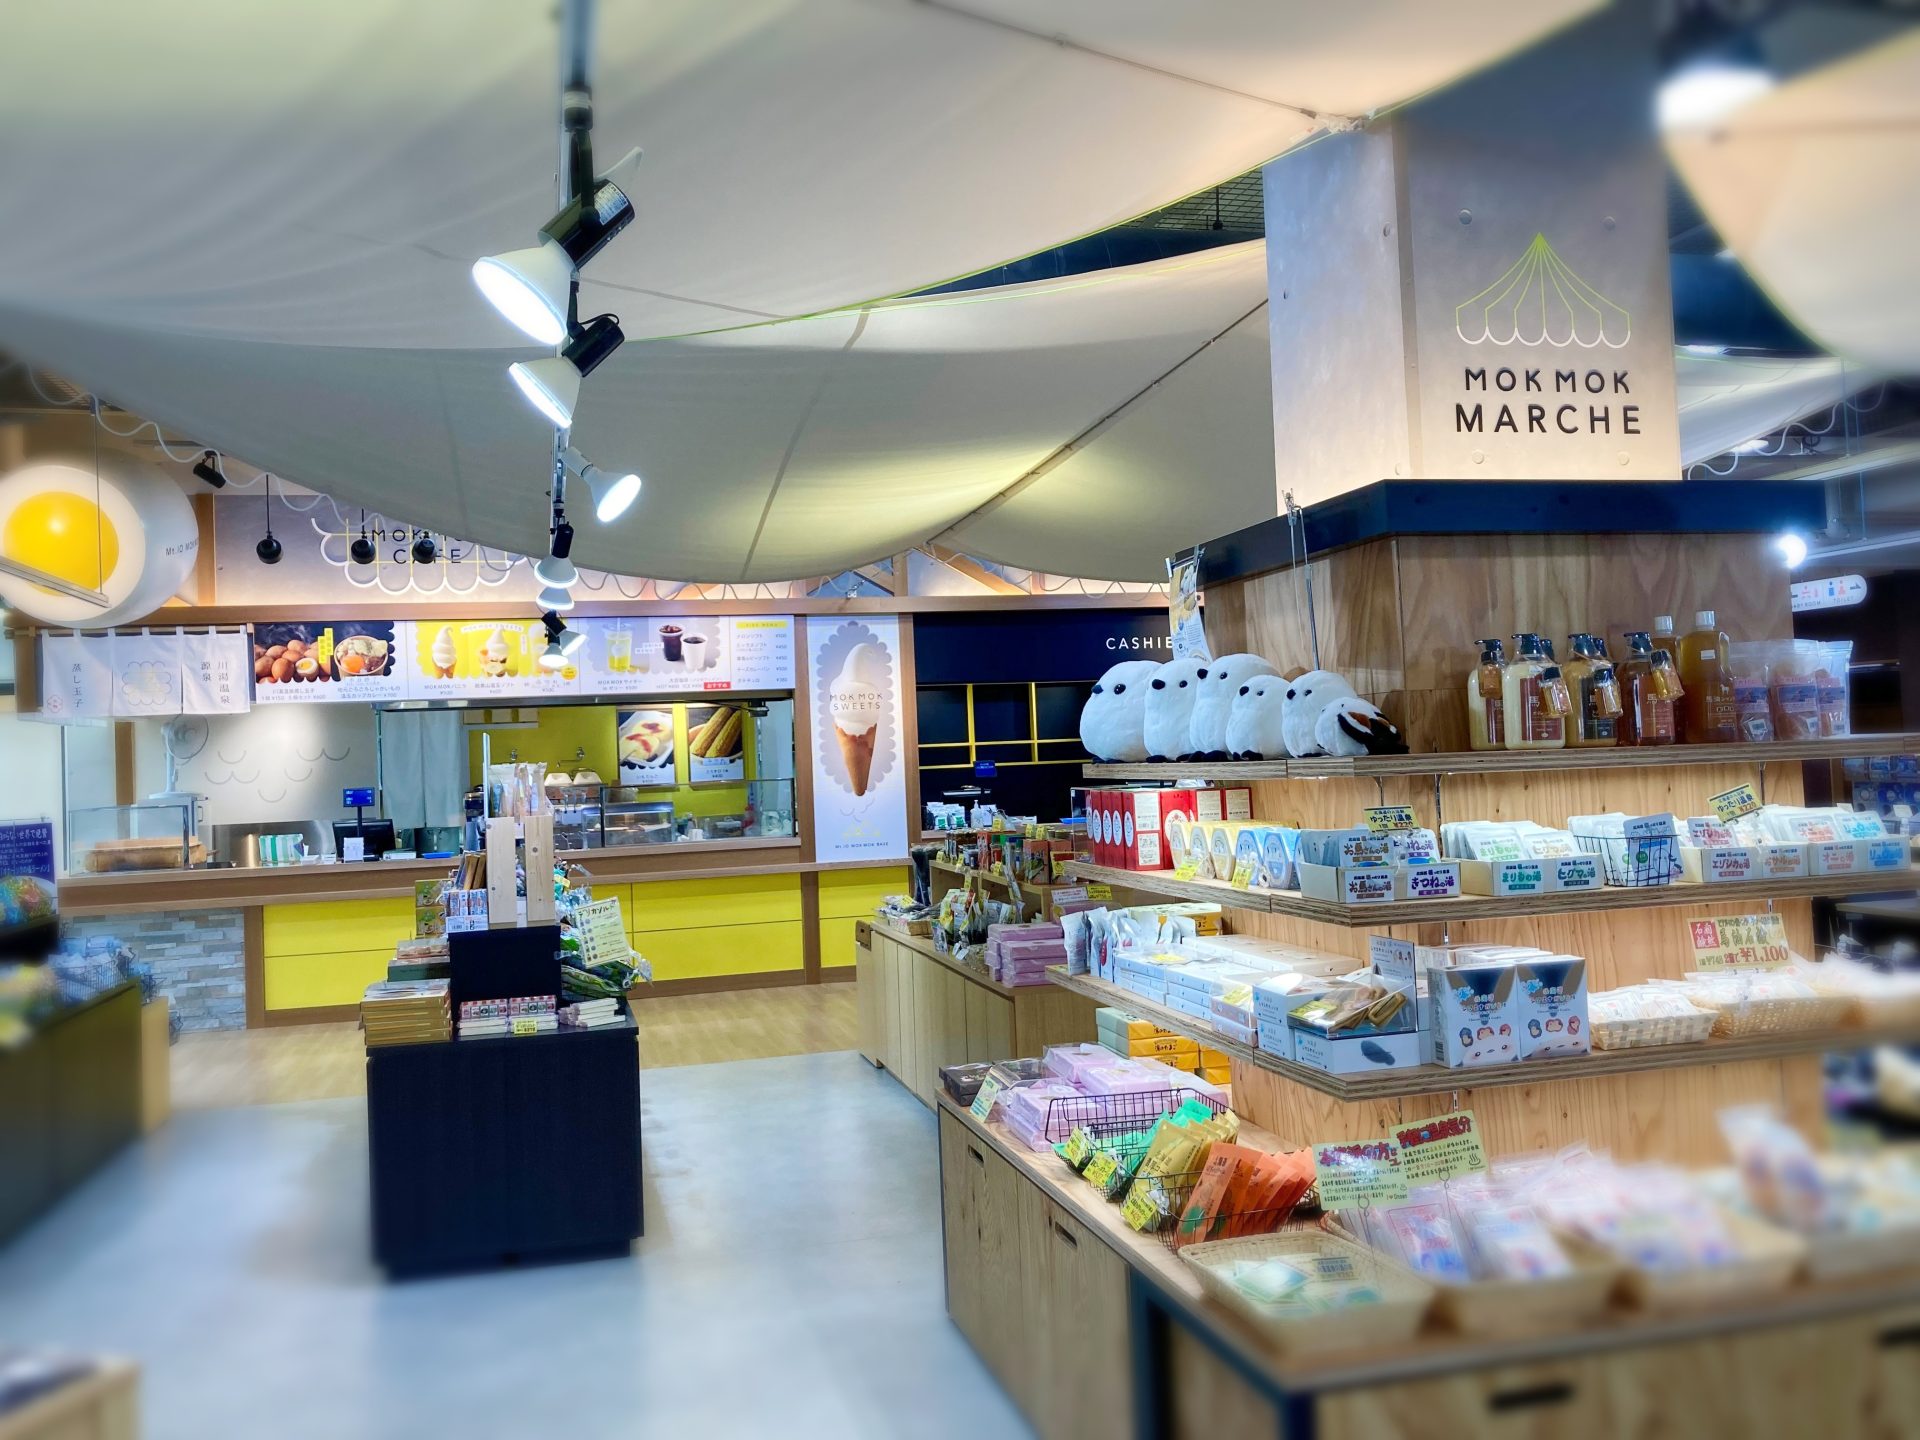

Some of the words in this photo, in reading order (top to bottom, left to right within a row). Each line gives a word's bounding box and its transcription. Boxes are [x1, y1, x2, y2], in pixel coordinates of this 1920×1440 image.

[1455, 402, 1641, 435] MARCHE
[1106, 636, 1173, 650] CASHIE
[71, 663, 84, 708] 蒸し玉子
[833, 701, 882, 711] SWEETS
[1712, 858, 1751, 870] エゾシカの湯
[1502, 870, 1542, 883] まりもの湯
[1557, 867, 1596, 880] ヒグマの湯
[1348, 880, 1393, 893] お馬さんの湯
[1411, 875, 1455, 890] きつねの湯
[1739, 945, 1789, 963] ¥1,100
